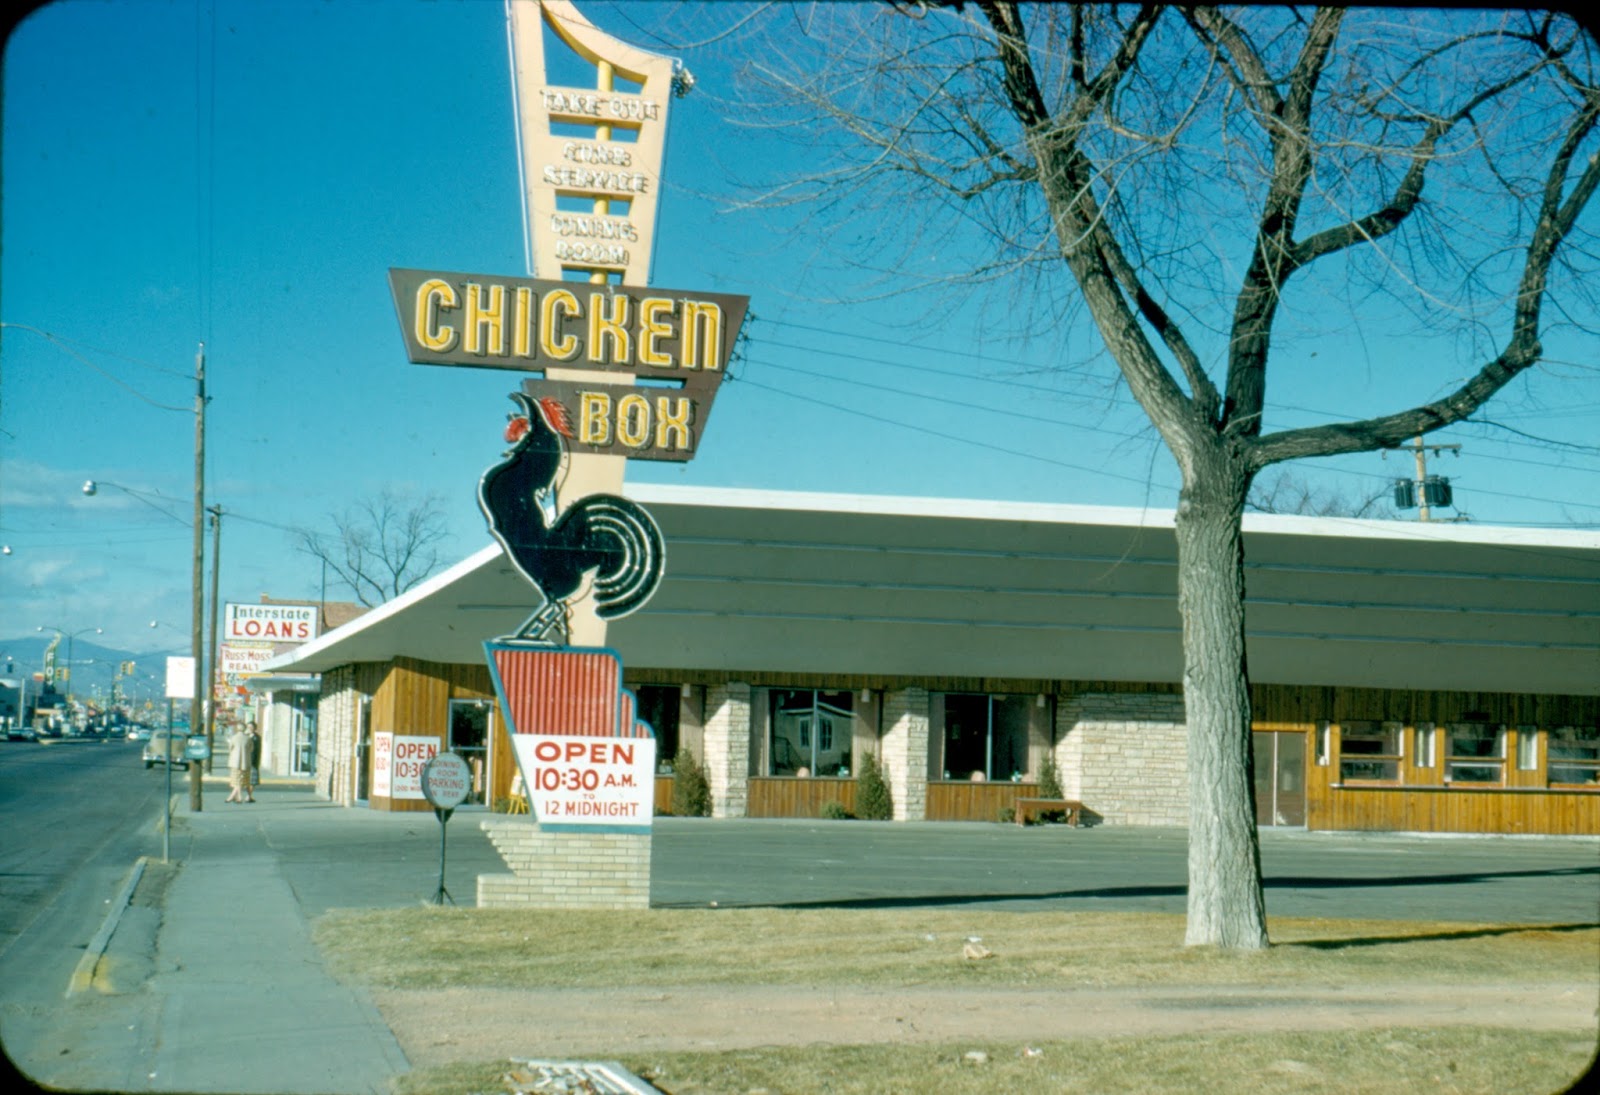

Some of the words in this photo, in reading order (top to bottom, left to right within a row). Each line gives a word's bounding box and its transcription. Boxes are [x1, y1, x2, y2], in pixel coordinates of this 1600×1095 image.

[564, 142, 632, 167] CURB
[544, 165, 648, 193] SERVICE
[551, 214, 638, 242] DINING
[556, 240, 630, 266] ROOM
[414, 279, 722, 370] CHICKEN
[579, 391, 690, 450] BOX
[232, 605, 310, 620] Interstate
[232, 620, 309, 638] LOANS
[396, 743, 437, 760] OPEN
[534, 741, 634, 765] OPEN
[428, 777, 465, 789] PARKING
[534, 768, 600, 791] 10:30
[603, 773, 637, 788] A.M.
[545, 801, 560, 815] 12
[565, 801, 640, 817] MIDNIGHT
